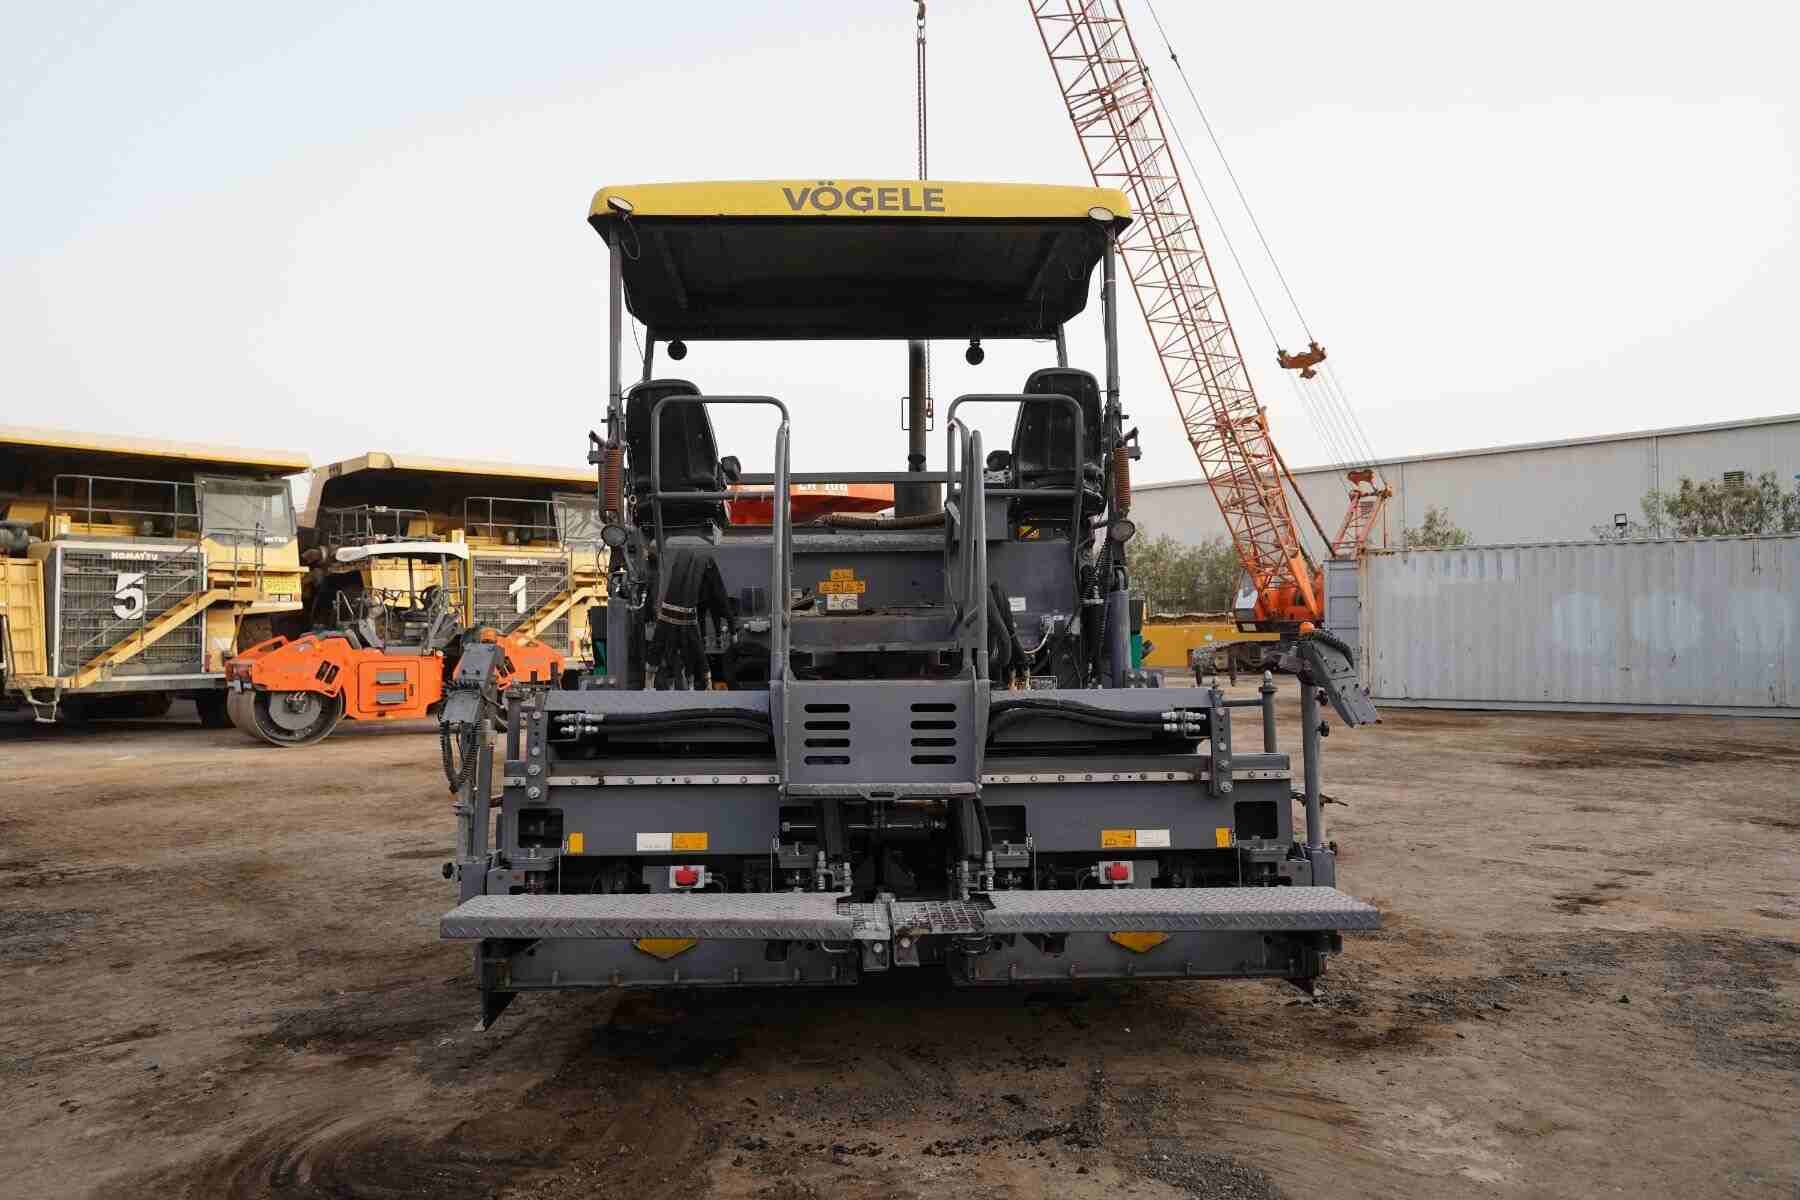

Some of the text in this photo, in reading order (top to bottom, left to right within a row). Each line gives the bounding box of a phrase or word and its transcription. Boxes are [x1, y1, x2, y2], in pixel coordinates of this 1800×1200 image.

[782, 181, 945, 212] VÖGELE
[113, 573, 148, 620] 5
[509, 576, 527, 614] 1
